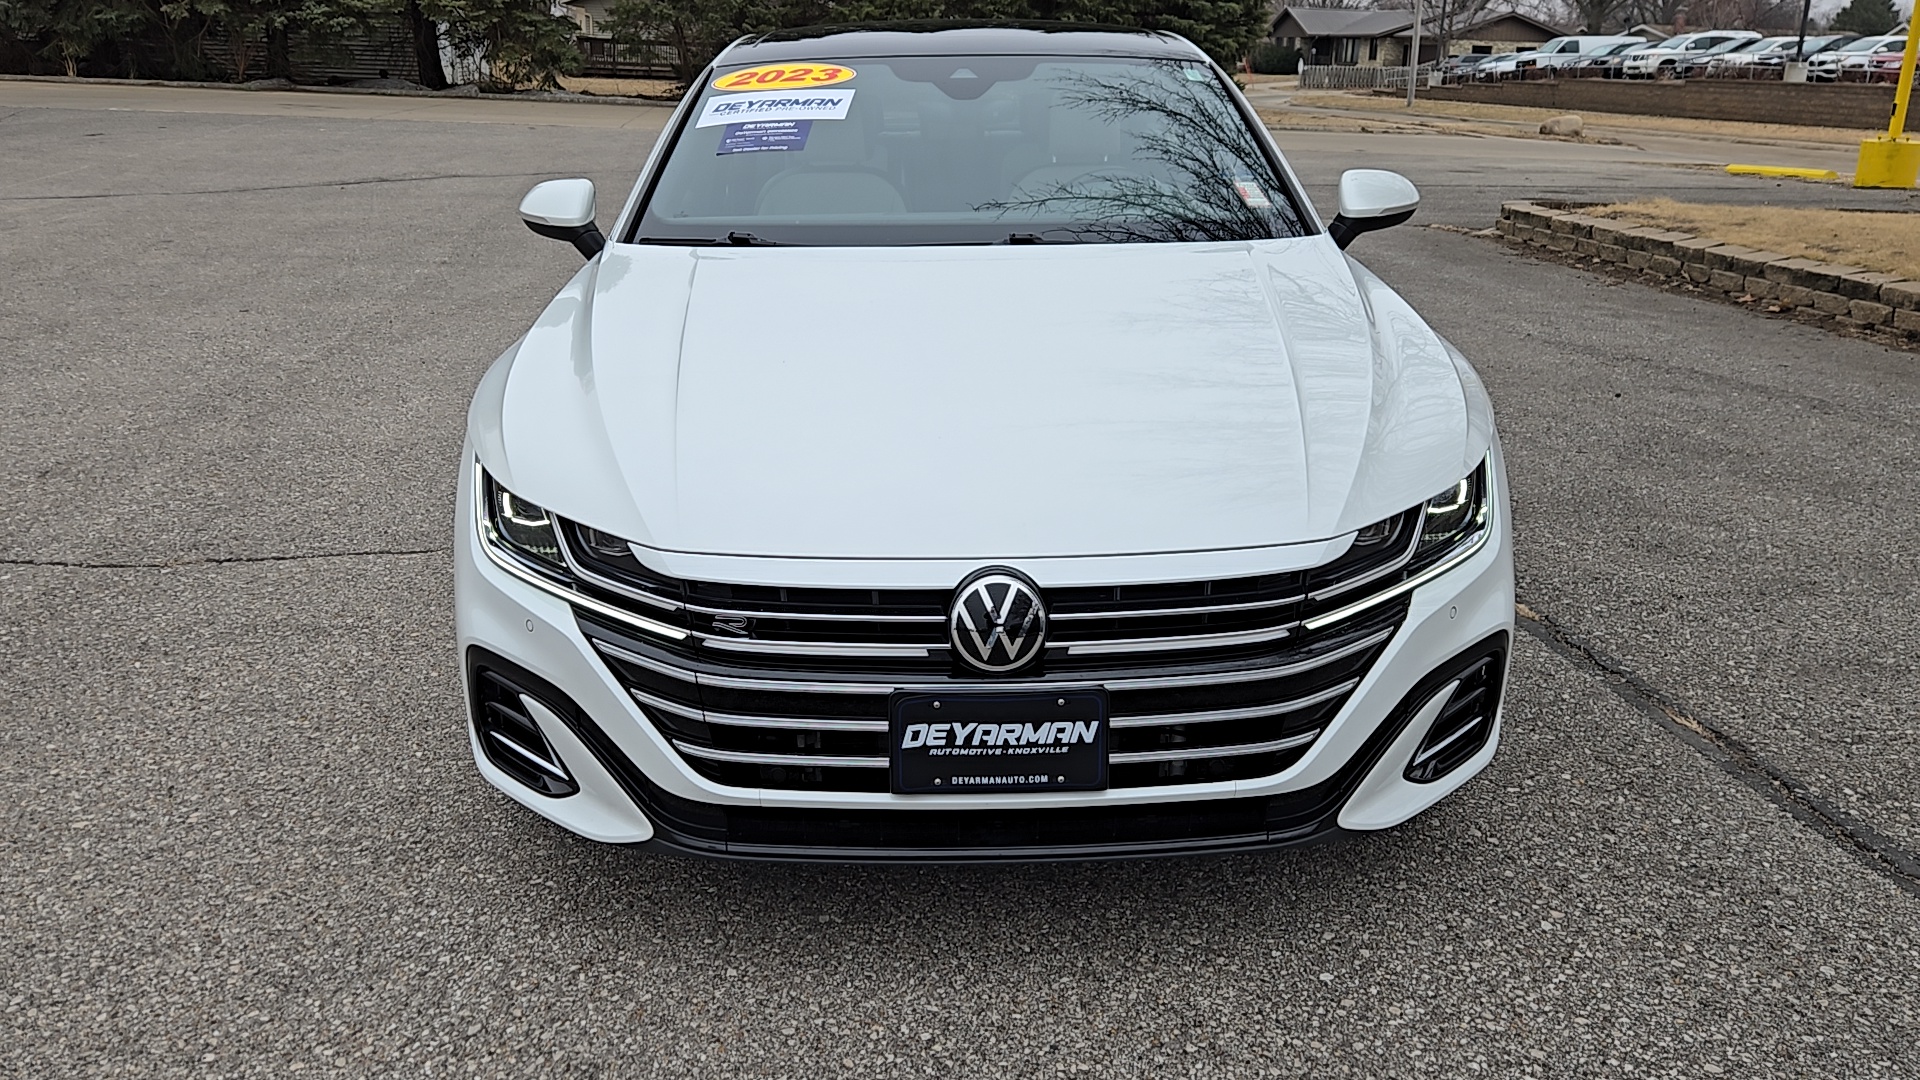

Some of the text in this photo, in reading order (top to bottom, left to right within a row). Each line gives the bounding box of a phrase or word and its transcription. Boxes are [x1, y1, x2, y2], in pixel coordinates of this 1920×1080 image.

[724, 68, 842, 87] 2023
[712, 98, 843, 113] DEYARMAN
[720, 106, 772, 116] CERTIFIED
[902, 721, 1100, 749] DEYARMAN
[951, 775, 1049, 785] DEYARMANAUTO.COM
